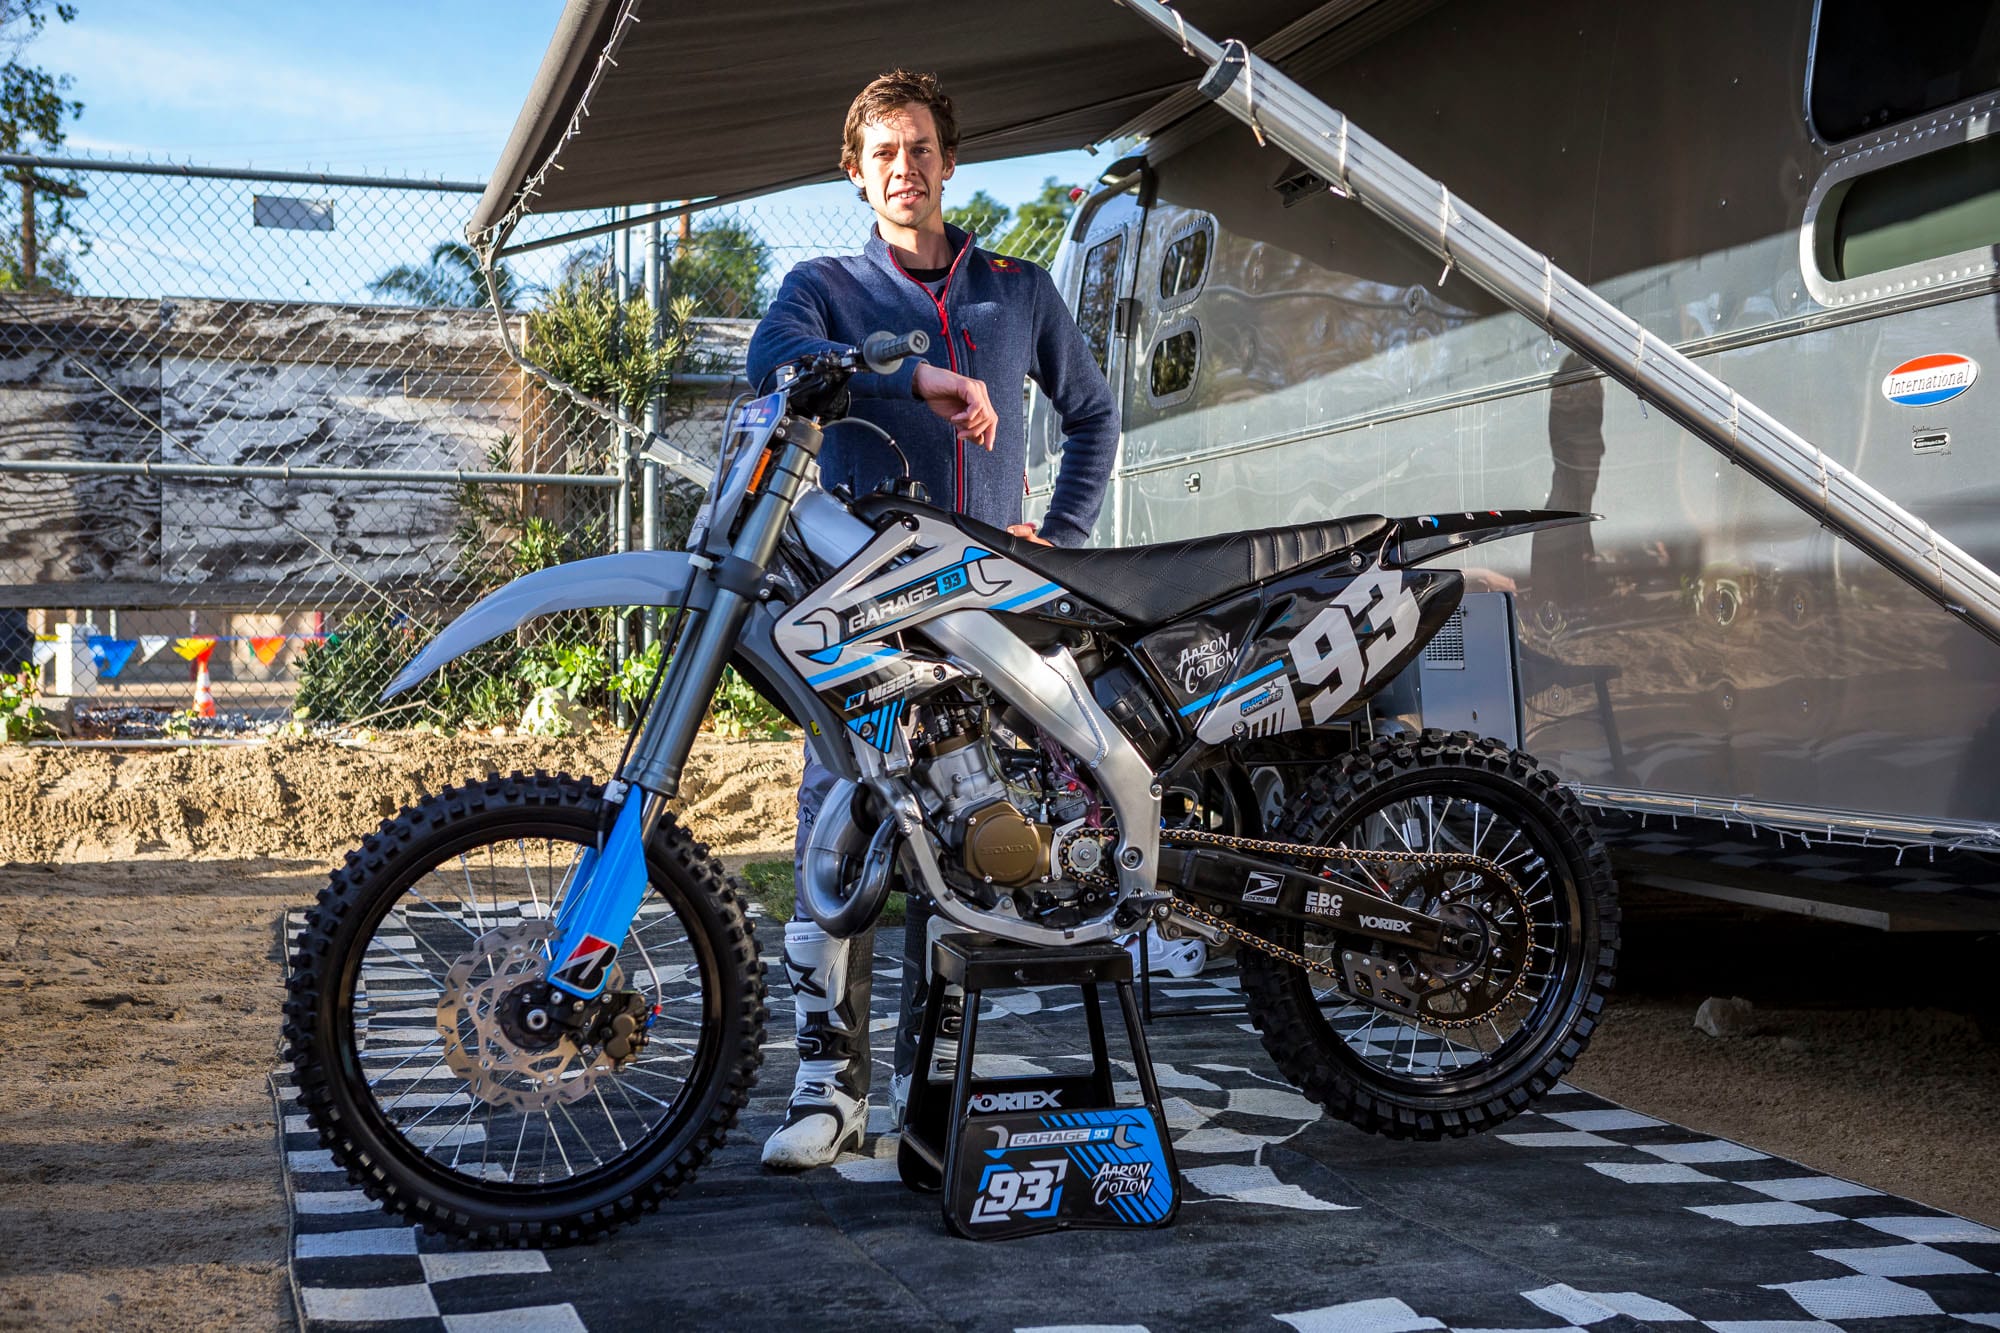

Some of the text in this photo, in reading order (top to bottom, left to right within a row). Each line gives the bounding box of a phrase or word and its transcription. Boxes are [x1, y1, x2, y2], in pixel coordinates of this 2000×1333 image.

[1887, 364, 1971, 396] International
[849, 571, 961, 633] GARAGE 93
[1175, 632, 1230, 680] AARON
[1288, 560, 1421, 725] 93
[1185, 647, 1239, 694] COLTON
[1304, 905, 1341, 917] BRAKES
[1306, 890, 1344, 909] EBC
[1359, 914, 1413, 934] VORTEX
[1013, 1127, 1110, 1145] GARAGE 93
[983, 1168, 1055, 1213] 93
[1092, 1163, 1151, 1189] AARON
[1095, 1177, 1153, 1205] COLTON
